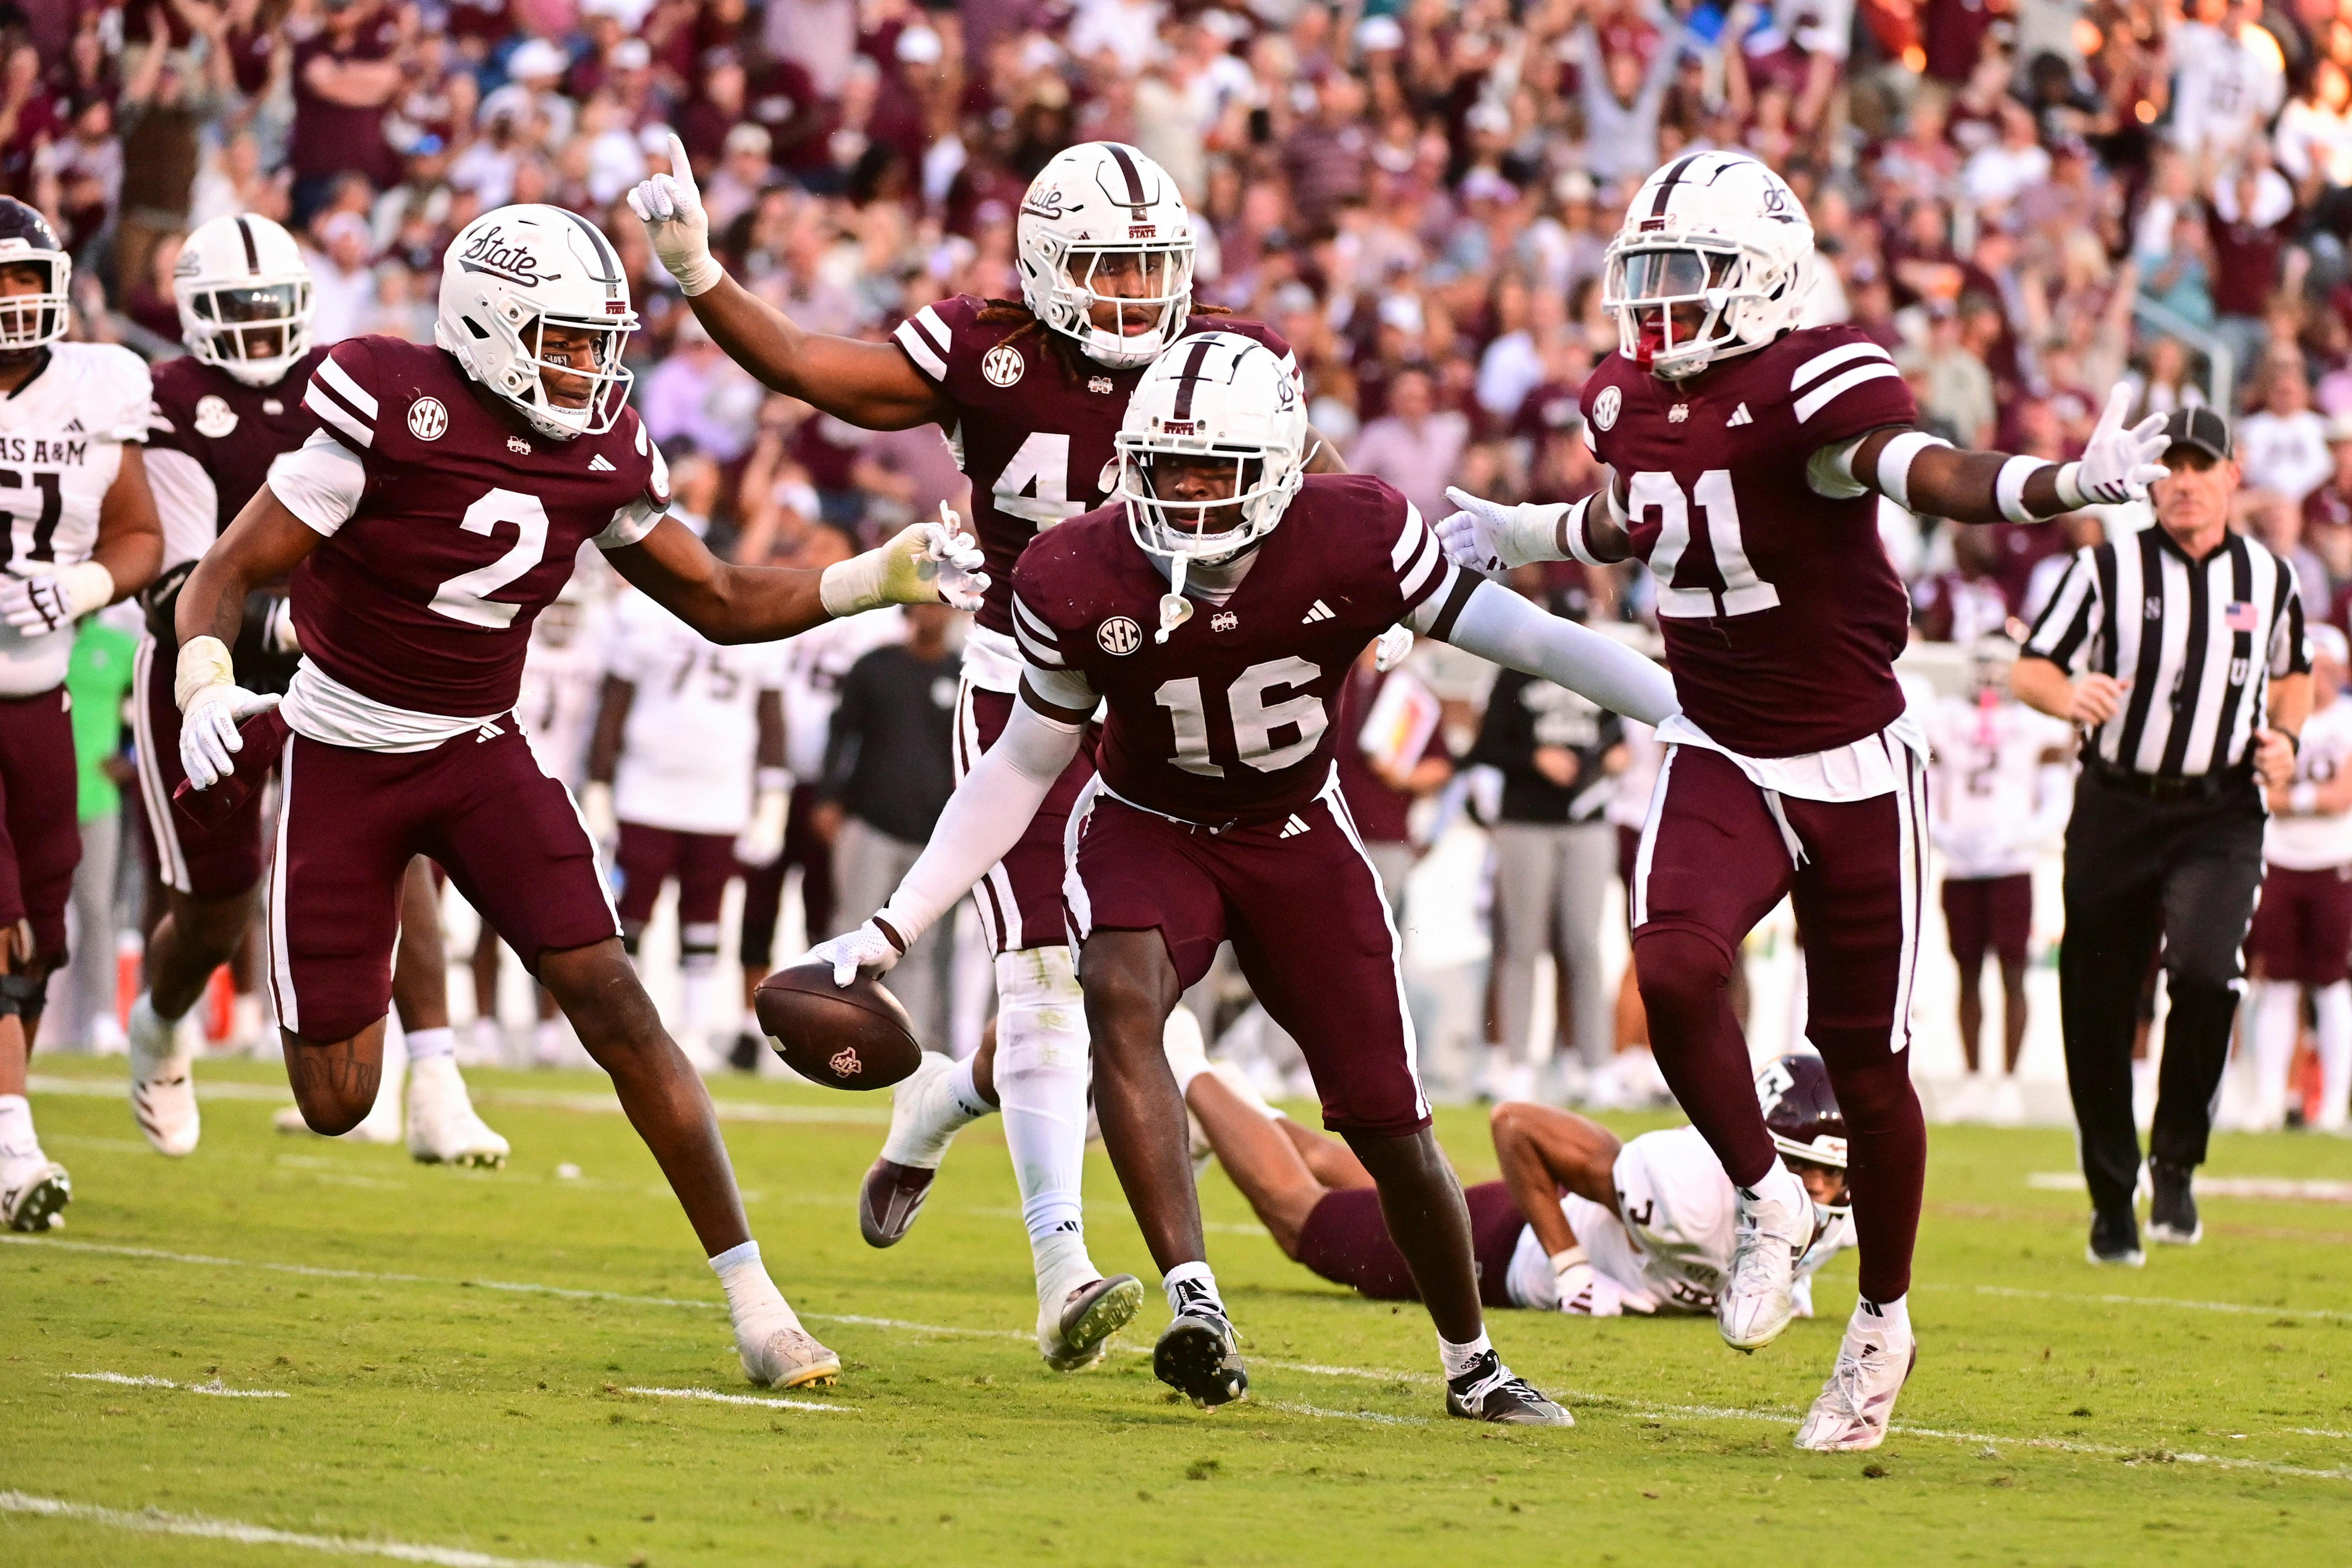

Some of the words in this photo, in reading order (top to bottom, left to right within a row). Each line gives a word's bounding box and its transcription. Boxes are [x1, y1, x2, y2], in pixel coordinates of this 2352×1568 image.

[1129, 229, 1156, 239] STATE
[459, 226, 540, 286] State
[985, 348, 1021, 384] SEC
[410, 400, 445, 437] SEC
[1595, 390, 1620, 428] SEC
[1164, 426, 1194, 436] STATE
[34, 440, 87, 465] A&M
[427, 487, 550, 629] 2
[1628, 469, 1782, 618] 21
[1100, 620, 1139, 653] SEC
[1154, 655, 1329, 781] 16
[1178, 1285, 1191, 1305] ADIZER
[1461, 1358, 1482, 1369] adid
